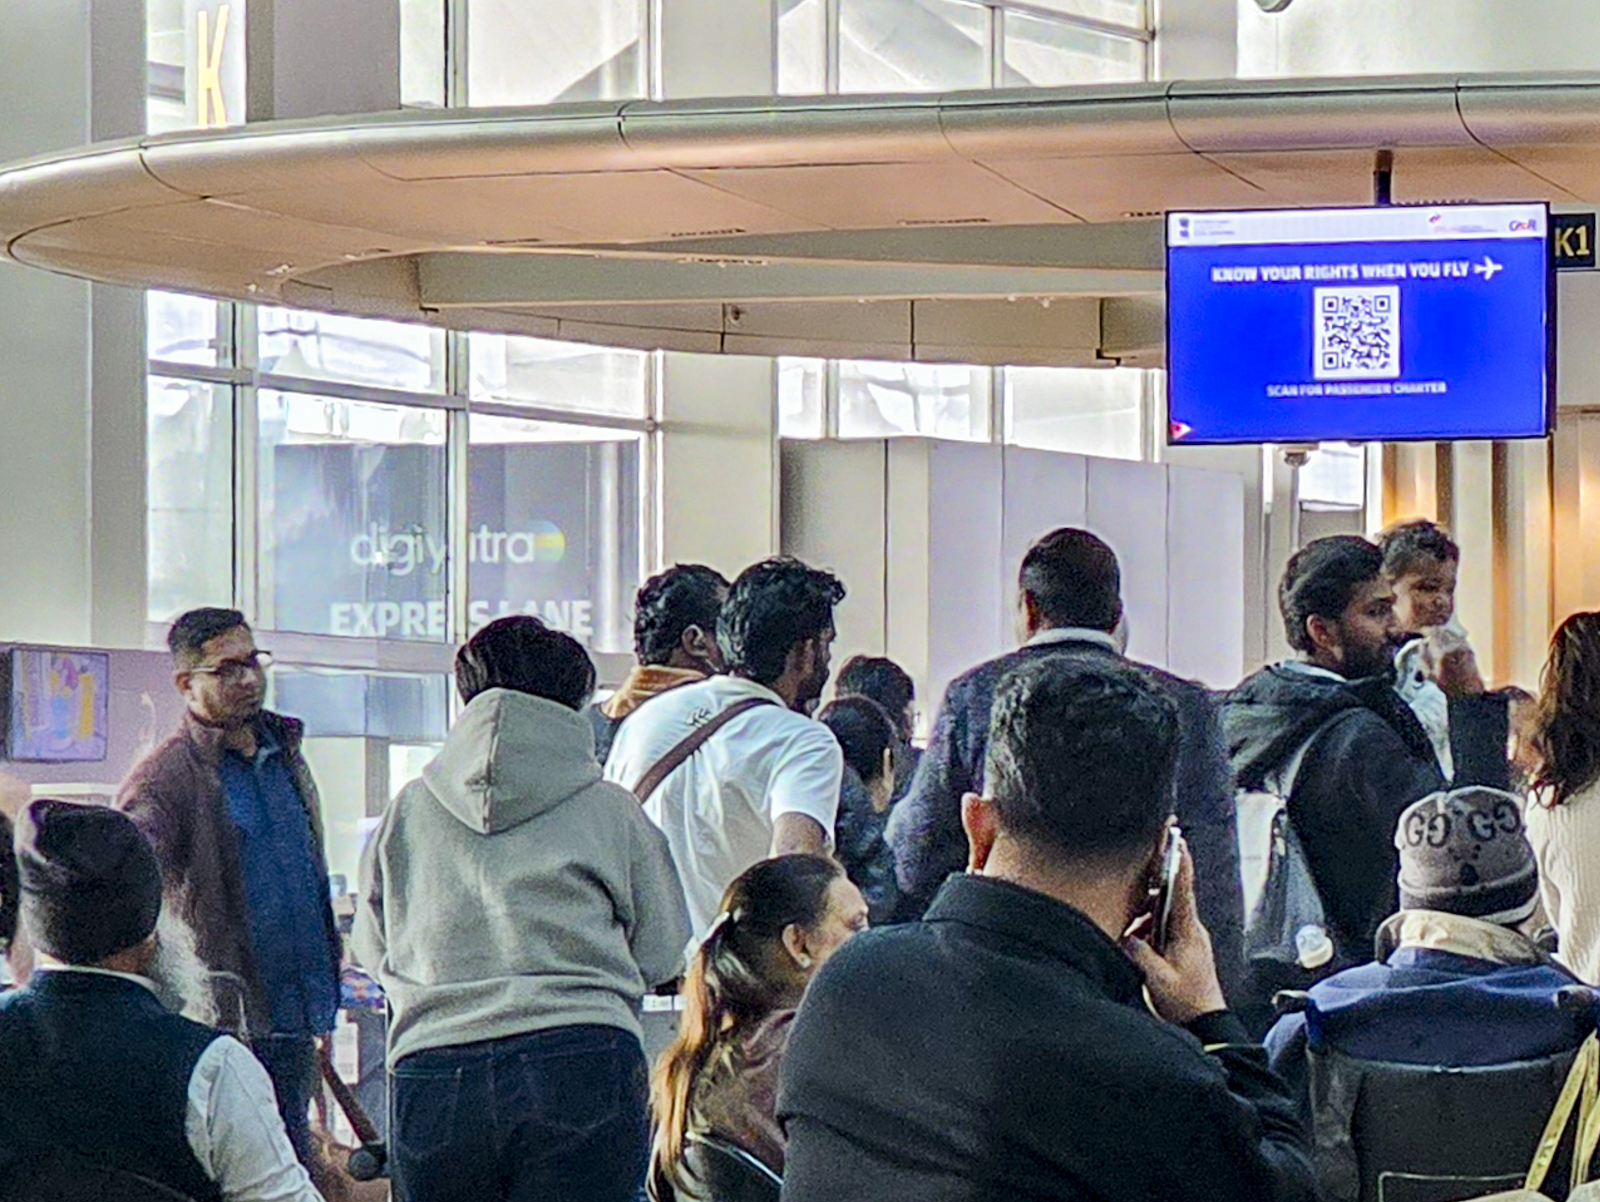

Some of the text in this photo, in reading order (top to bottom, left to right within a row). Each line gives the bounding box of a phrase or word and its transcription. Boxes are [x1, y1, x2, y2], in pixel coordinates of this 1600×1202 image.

[197, 4, 229, 129] K
[1554, 225, 1590, 257] K1
[1211, 261, 1470, 283] KNOW YOUR RIGHTS WHEN YOU FLY
[1266, 381, 1447, 397] SCAN FOR PASSENGER CHARTER
[350, 521, 535, 576] digiytra
[330, 600, 489, 636] EXPRES
